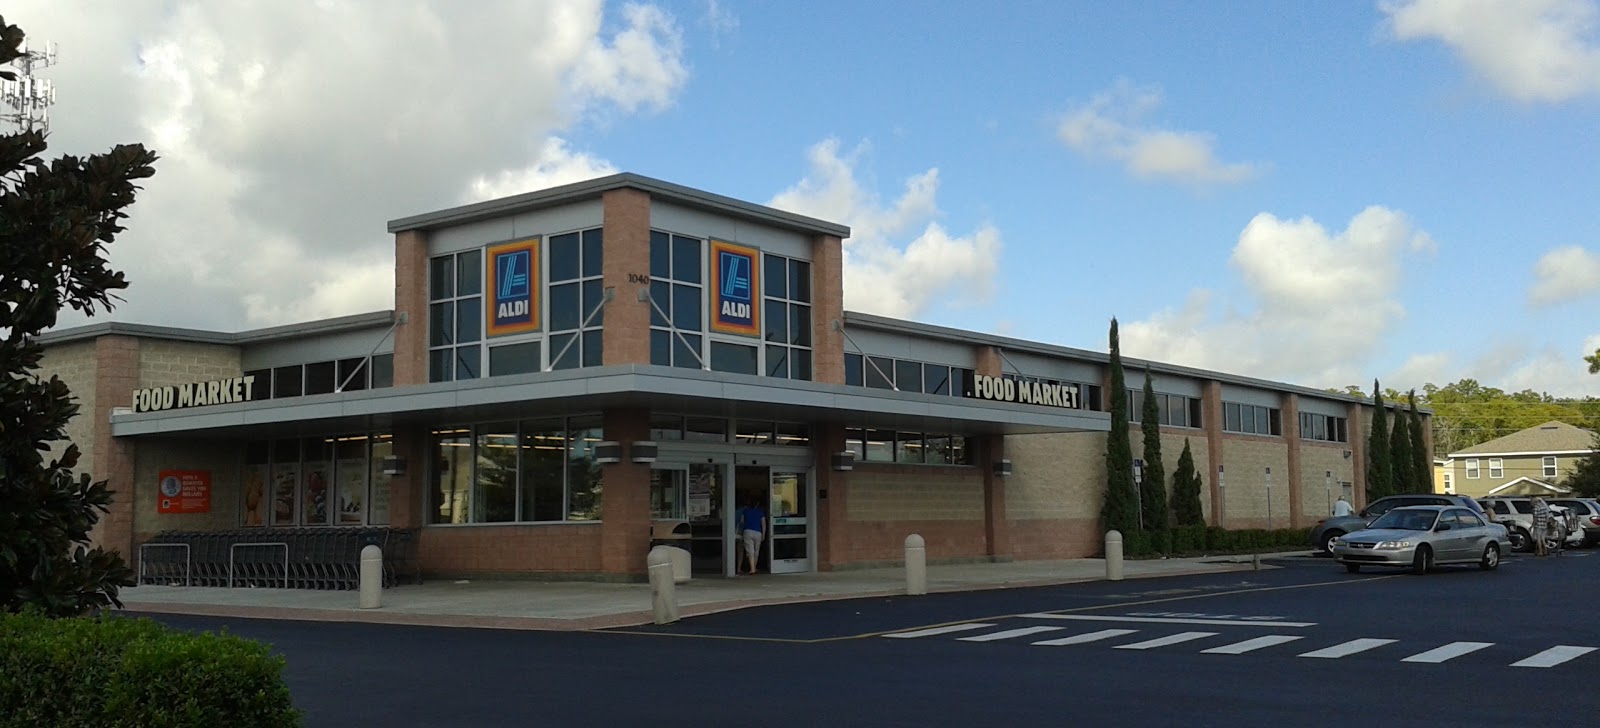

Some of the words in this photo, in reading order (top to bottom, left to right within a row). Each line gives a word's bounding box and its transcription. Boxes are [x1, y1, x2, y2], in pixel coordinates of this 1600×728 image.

[628, 273, 650, 285] 1040
[498, 300, 529, 318] ALDI
[721, 300, 750, 319] ALDI
[131, 386, 174, 413] FOOD
[178, 375, 255, 408] MARKET
[974, 374, 1015, 402] FOOD
[1018, 381, 1078, 408] MARKET
